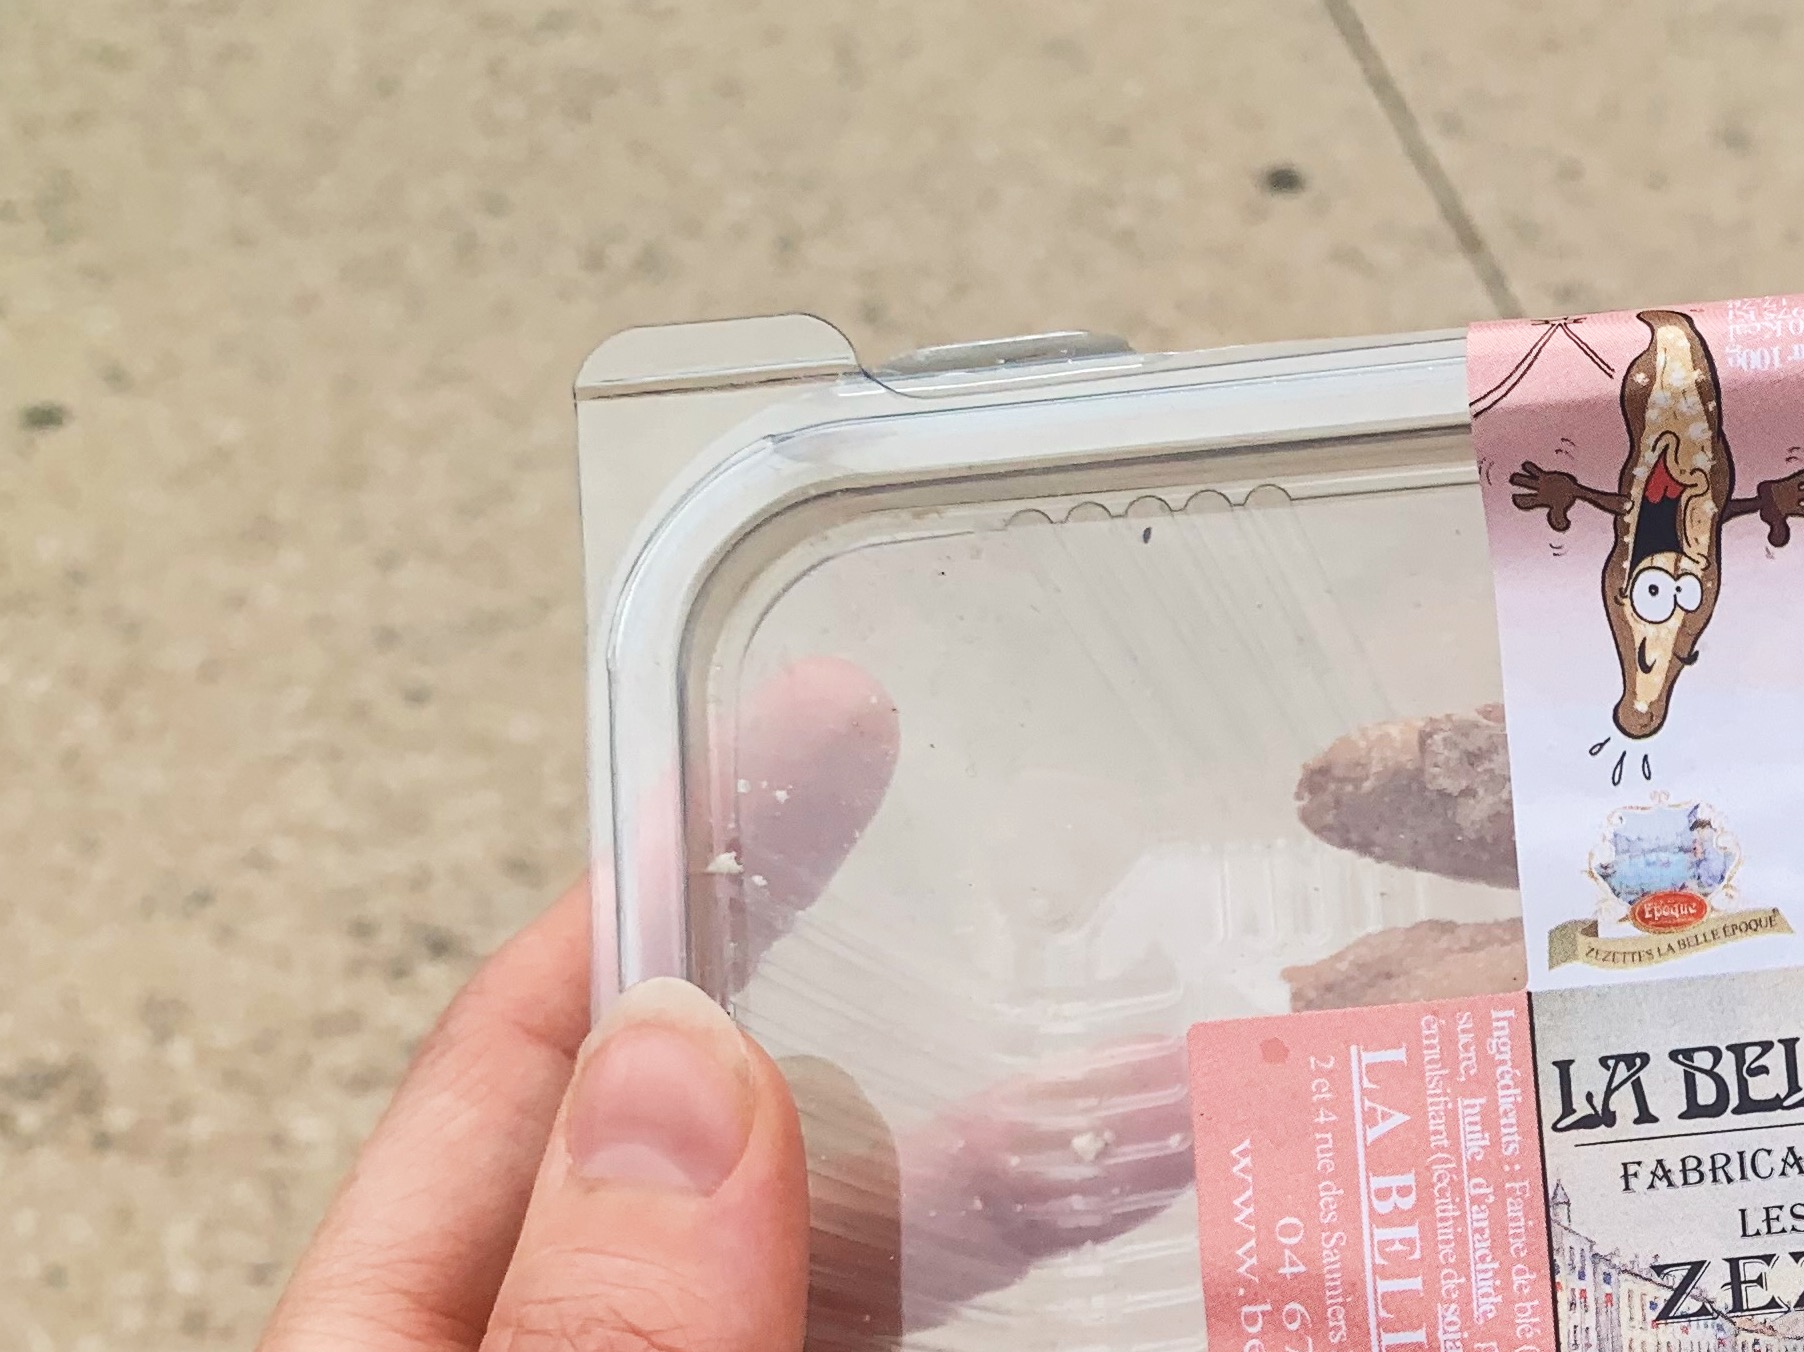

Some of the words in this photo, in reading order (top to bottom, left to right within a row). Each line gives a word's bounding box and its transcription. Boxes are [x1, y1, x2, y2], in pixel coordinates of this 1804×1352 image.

[1726, 342, 1783, 371] 100g
[1656, 941, 1676, 958] LA
[1677, 926, 1721, 951] BELLE
[1308, 1055, 1334, 1072] 2
[1311, 1077, 1331, 1102] et
[1361, 1045, 1412, 1146] LA
[1551, 1051, 1660, 1132] LA
[1313, 1109, 1338, 1127] 4
[1458, 1097, 1489, 1161] huile
[1314, 1132, 1335, 1171] rue
[1418, 1014, 1452, 1148] émulsifiant
[1439, 1268, 1465, 1299] de
[1318, 1176, 1345, 1224] des
[1503, 1179, 1531, 1259] Farine
[1275, 1215, 1308, 1278] 04
[1320, 1230, 1350, 1343] Sauniers
[1510, 1263, 1535, 1295] de
[1514, 1301, 1539, 1340] blé
